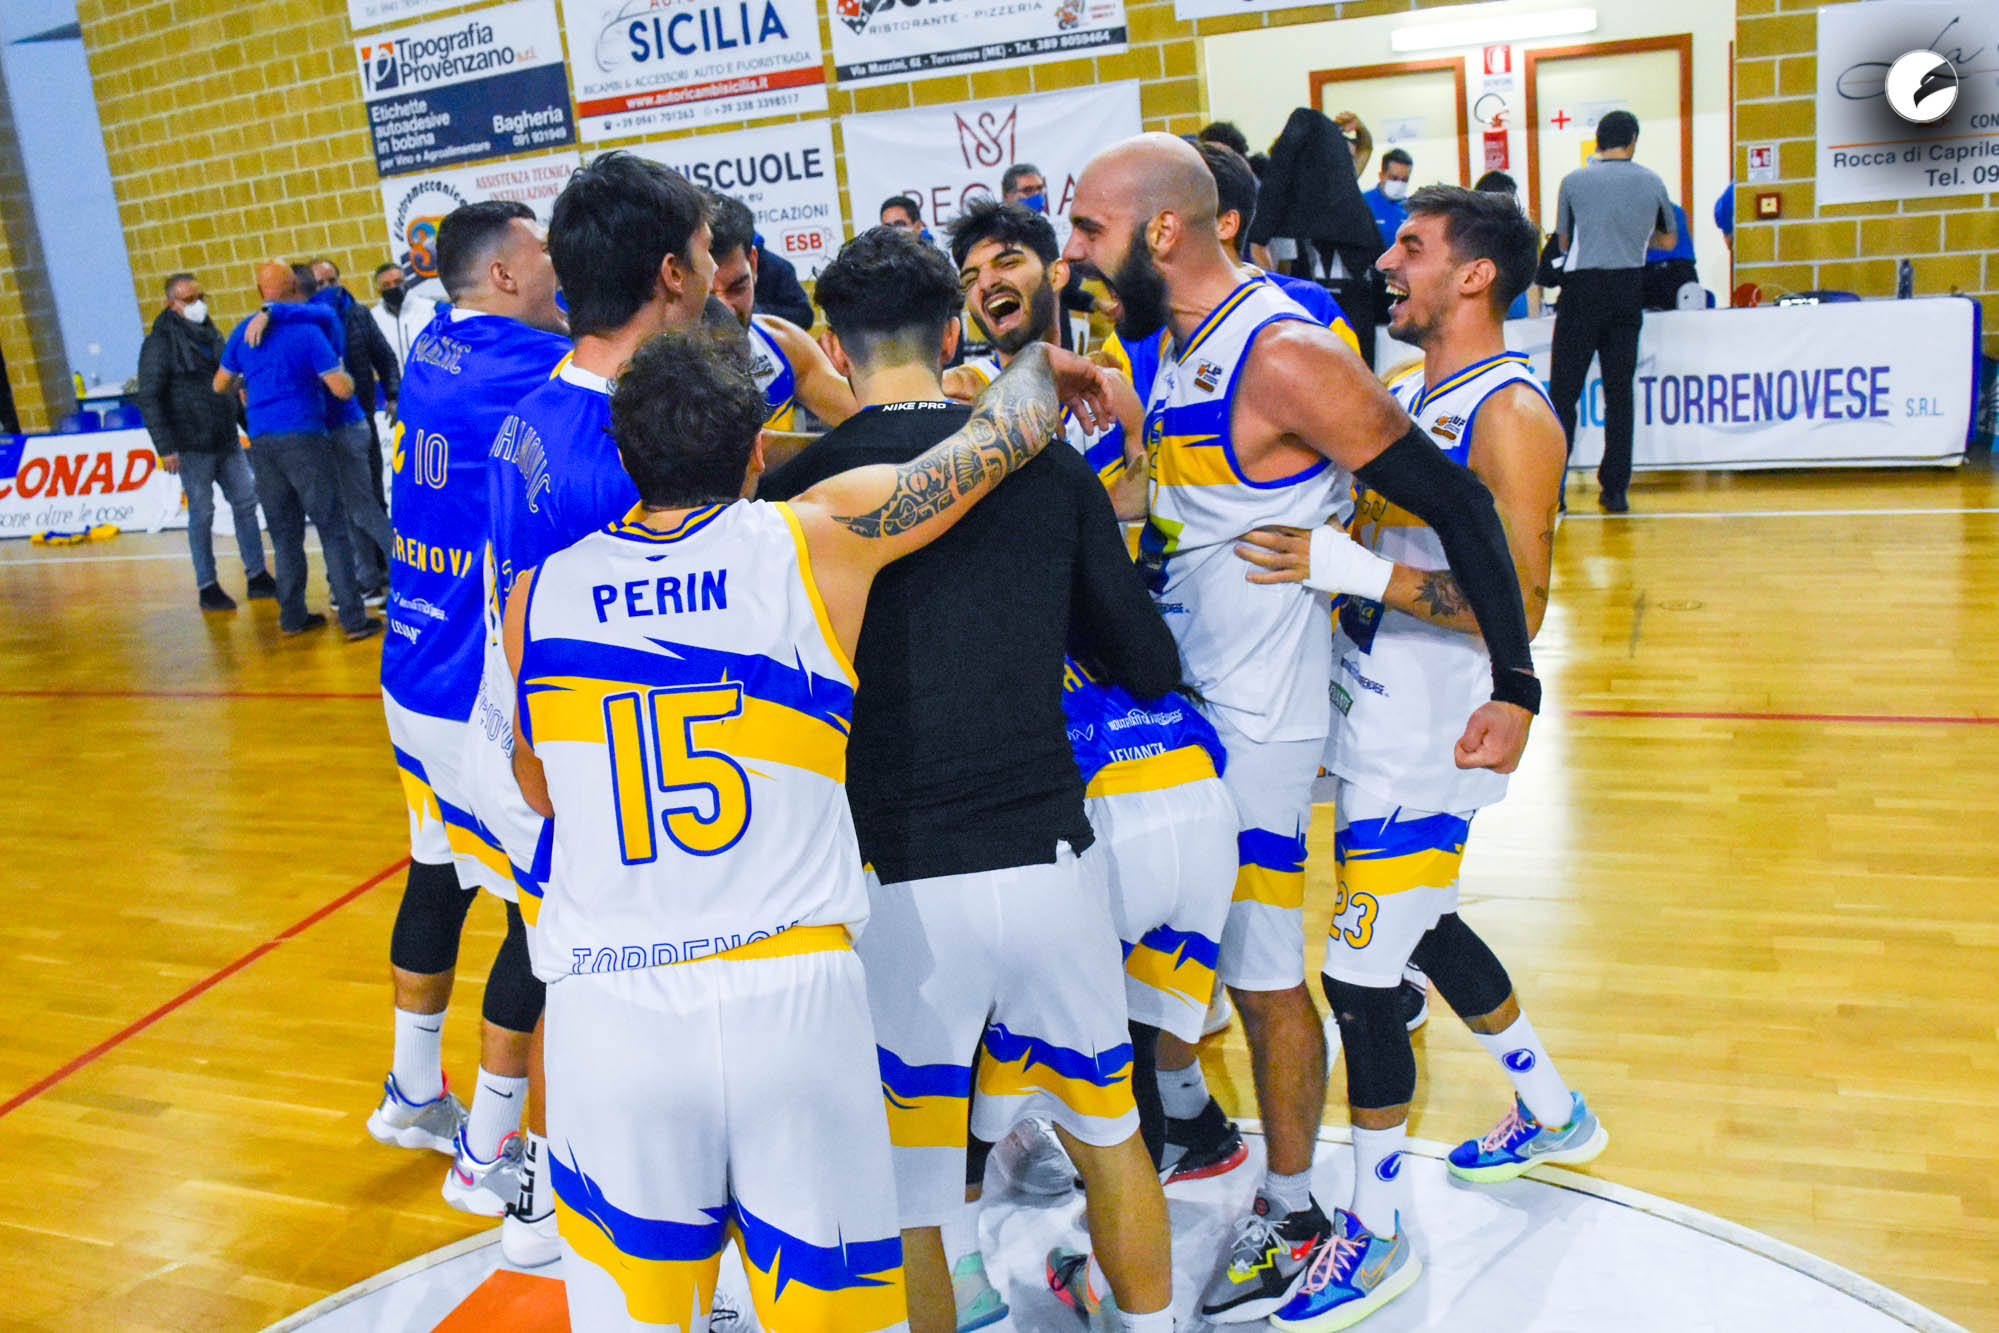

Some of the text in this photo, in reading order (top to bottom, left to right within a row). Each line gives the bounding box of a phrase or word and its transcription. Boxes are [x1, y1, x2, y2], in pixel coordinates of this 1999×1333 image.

[629, 0, 789, 62] SICILIA
[869, 13, 958, 35] RISTORANTE
[974, 2, 1042, 20] PIZZERIA
[395, 22, 494, 64] Tipografia
[400, 46, 515, 86] Provenzano
[634, 71, 689, 88] ACCESSORI
[694, 63, 725, 79] AUTO
[737, 51, 812, 71] FUORISTRADA
[371, 99, 428, 123] Etichette
[375, 112, 451, 140] autoadesive
[493, 105, 564, 134] Bagheria
[377, 131, 435, 155] in bobina
[1834, 151, 1897, 168] Rocca
[1903, 145, 1921, 163] di
[1924, 167, 1965, 187] Tel.
[785, 232, 823, 251] ESB
[882, 402, 947, 412] NIKE PRO
[1639, 366, 1890, 426] TORRENOVESE
[1906, 396, 1945, 418] S.R.L.
[0, 449, 156, 500] ONAD
[415, 429, 448, 489] 10
[592, 568, 727, 623] PERIN
[602, 681, 752, 866] 15
[1328, 880, 1379, 950] 23
